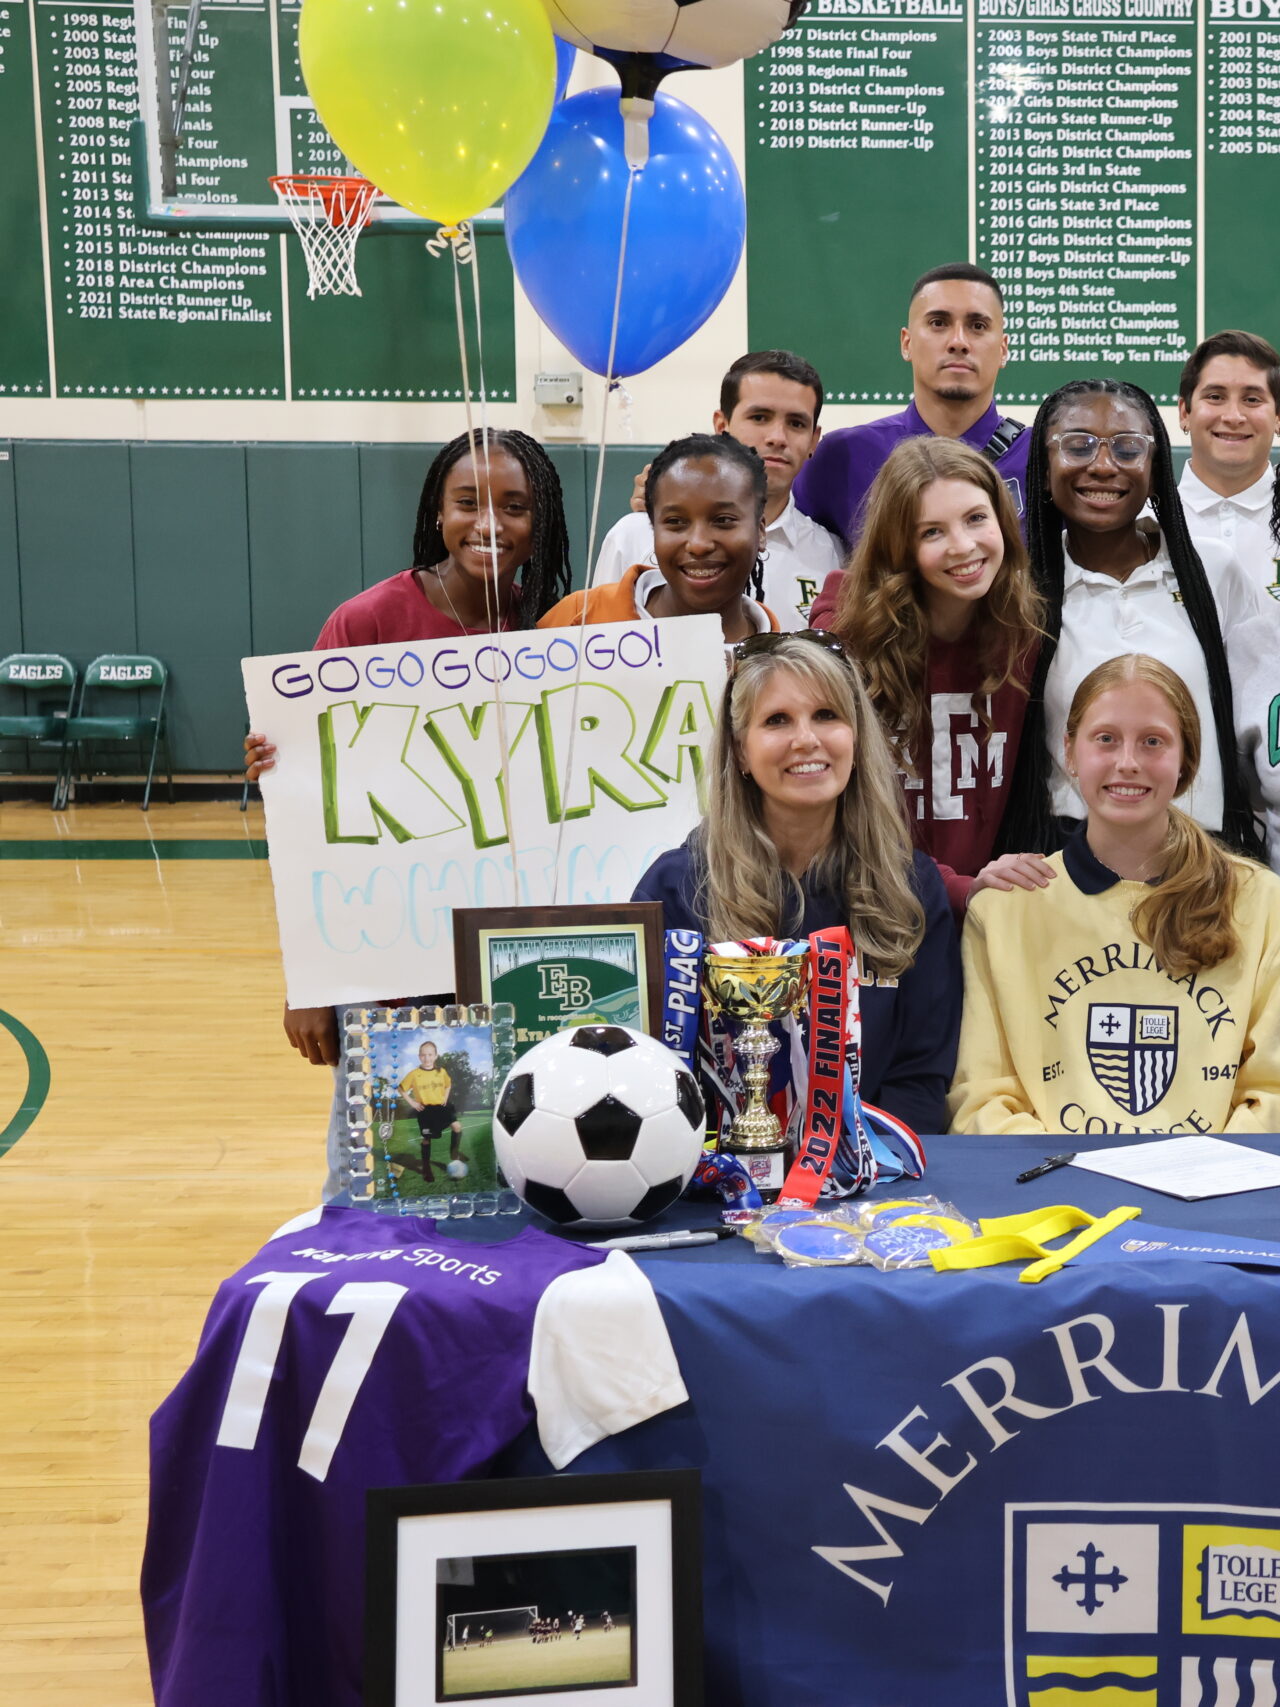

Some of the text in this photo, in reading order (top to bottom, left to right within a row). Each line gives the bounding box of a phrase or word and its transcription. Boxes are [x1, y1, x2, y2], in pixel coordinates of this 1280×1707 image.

[817, 0, 963, 15] BASKETBALL
[979, 0, 1193, 18] BOYS/GIRLS CROSS COUNTRY
[988, 30, 1176, 44] 2003 Boys State Third Place
[1220, 32, 1251, 43] 2001
[771, 46, 912, 59] 1998 State Final Four
[1220, 46, 1252, 58] 2002
[770, 64, 908, 79] 2008 Regional Finals
[1220, 62, 1252, 73] 2002
[770, 82, 944, 98] 2013 District Champions
[770, 100, 926, 117] 2013 State Runner-Up
[990, 163, 1141, 176] 2014 Girls 3rd in State
[990, 198, 1159, 211] 2015 Girls State 3rd Place
[76, 241, 265, 259] 2015 Bi-District Champions
[991, 250, 1190, 266] 2017 Boys District Runner-Up
[79, 292, 252, 310] 2021 District Runner Up
[80, 306, 272, 323] 2021 State Regional Finalist
[9, 664, 63, 680] EAGLES
[100, 664, 152, 681] EAGLES
[317, 680, 718, 849] KYRA
[1144, 1017, 1166, 1027] TOLLE
[1146, 1026, 1164, 1035] LEGE
[800, 936, 843, 1177] 2022 FINALIST
[1043, 1061, 1238, 1082] EST. 1947
[403, 1247, 503, 1286] Sports
[1218, 1579, 1278, 1607] LEGE
